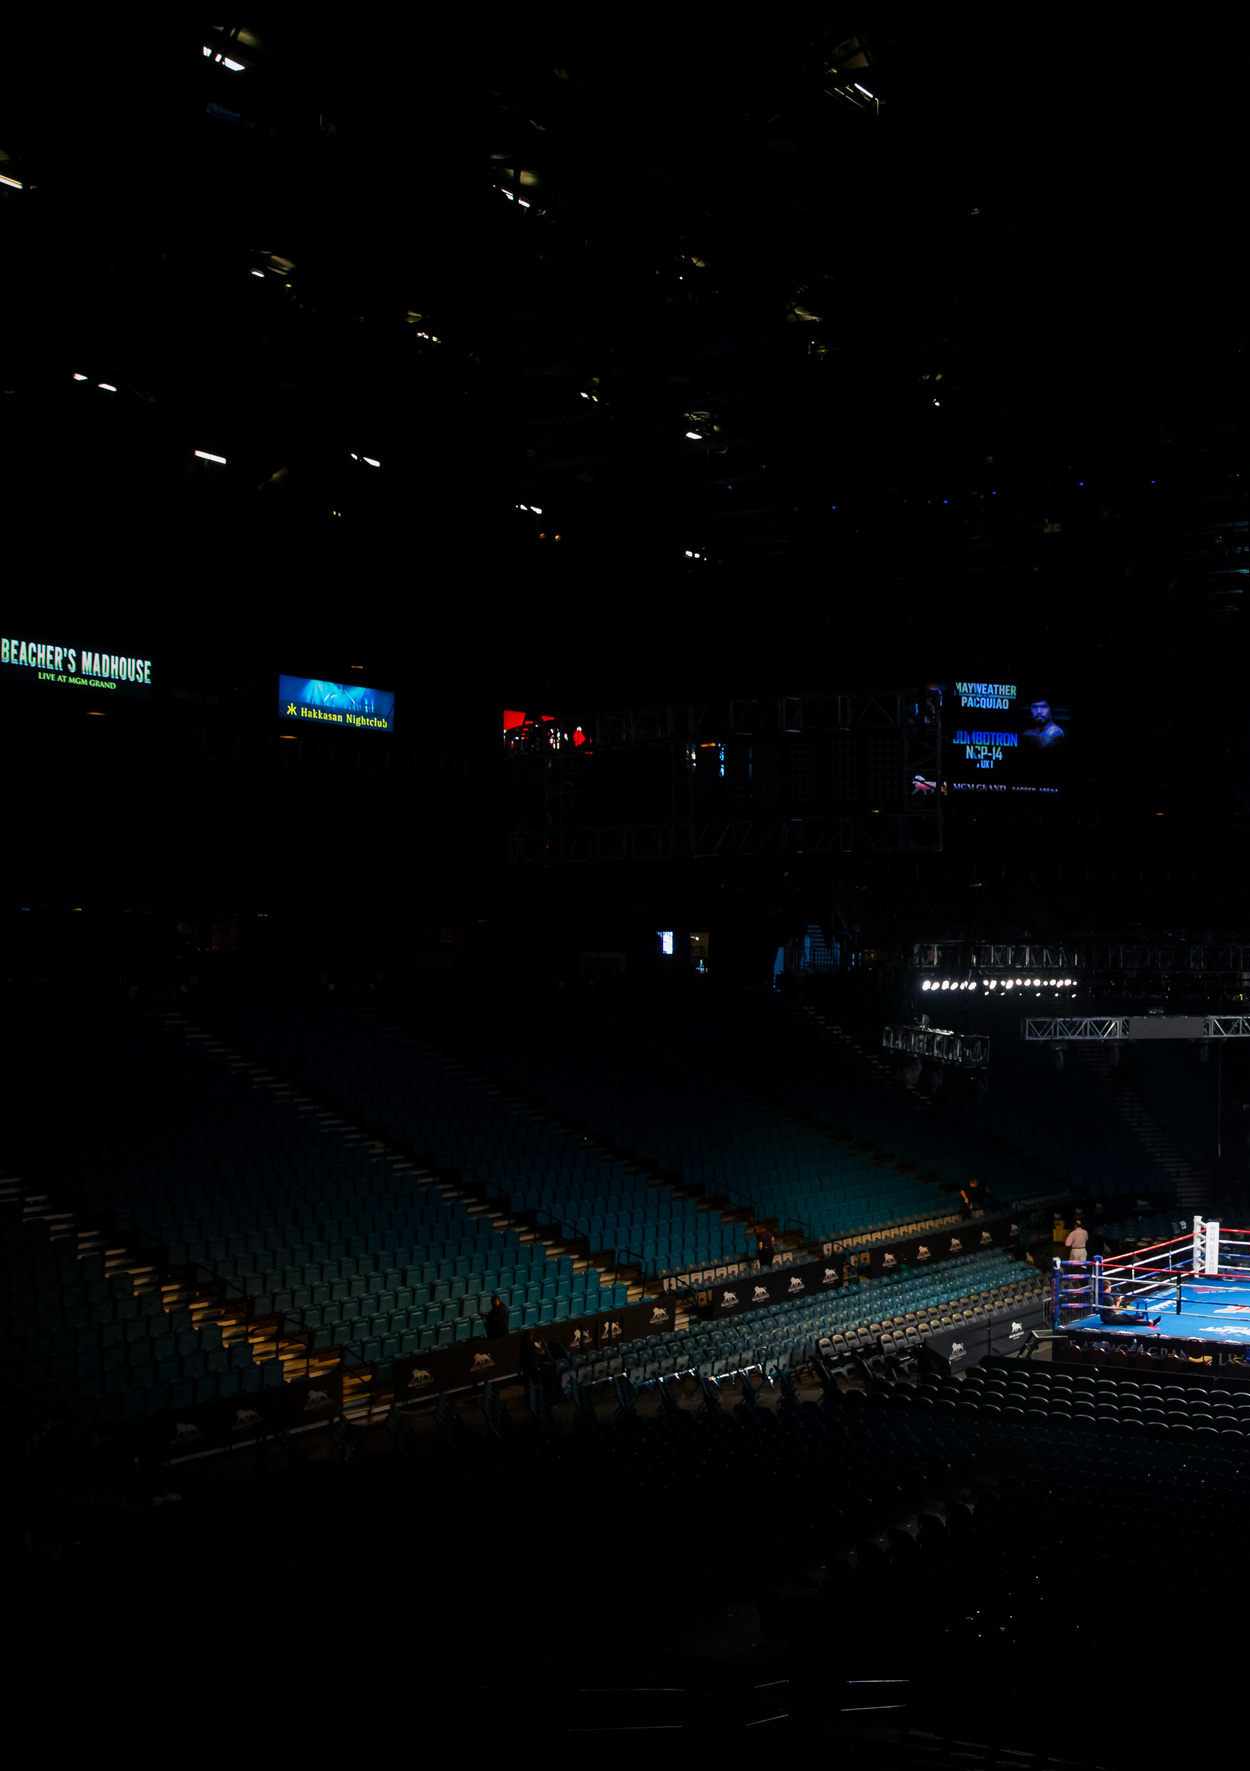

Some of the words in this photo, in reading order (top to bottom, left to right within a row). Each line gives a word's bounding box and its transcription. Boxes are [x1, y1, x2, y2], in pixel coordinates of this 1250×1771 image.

[1, 638, 77, 673] BEACHER'S
[81, 650, 152, 684] MADHOUSE
[38, 671, 56, 682] LIVE
[57, 674, 68, 683] AT
[68, 676, 88, 686] MGM
[89, 679, 117, 690] GRAND
[961, 696, 1010, 710] PACQUIAO
[300, 707, 343, 722] Hakkasan
[346, 713, 388, 729] Nightclub
[953, 783, 975, 791] MGM
